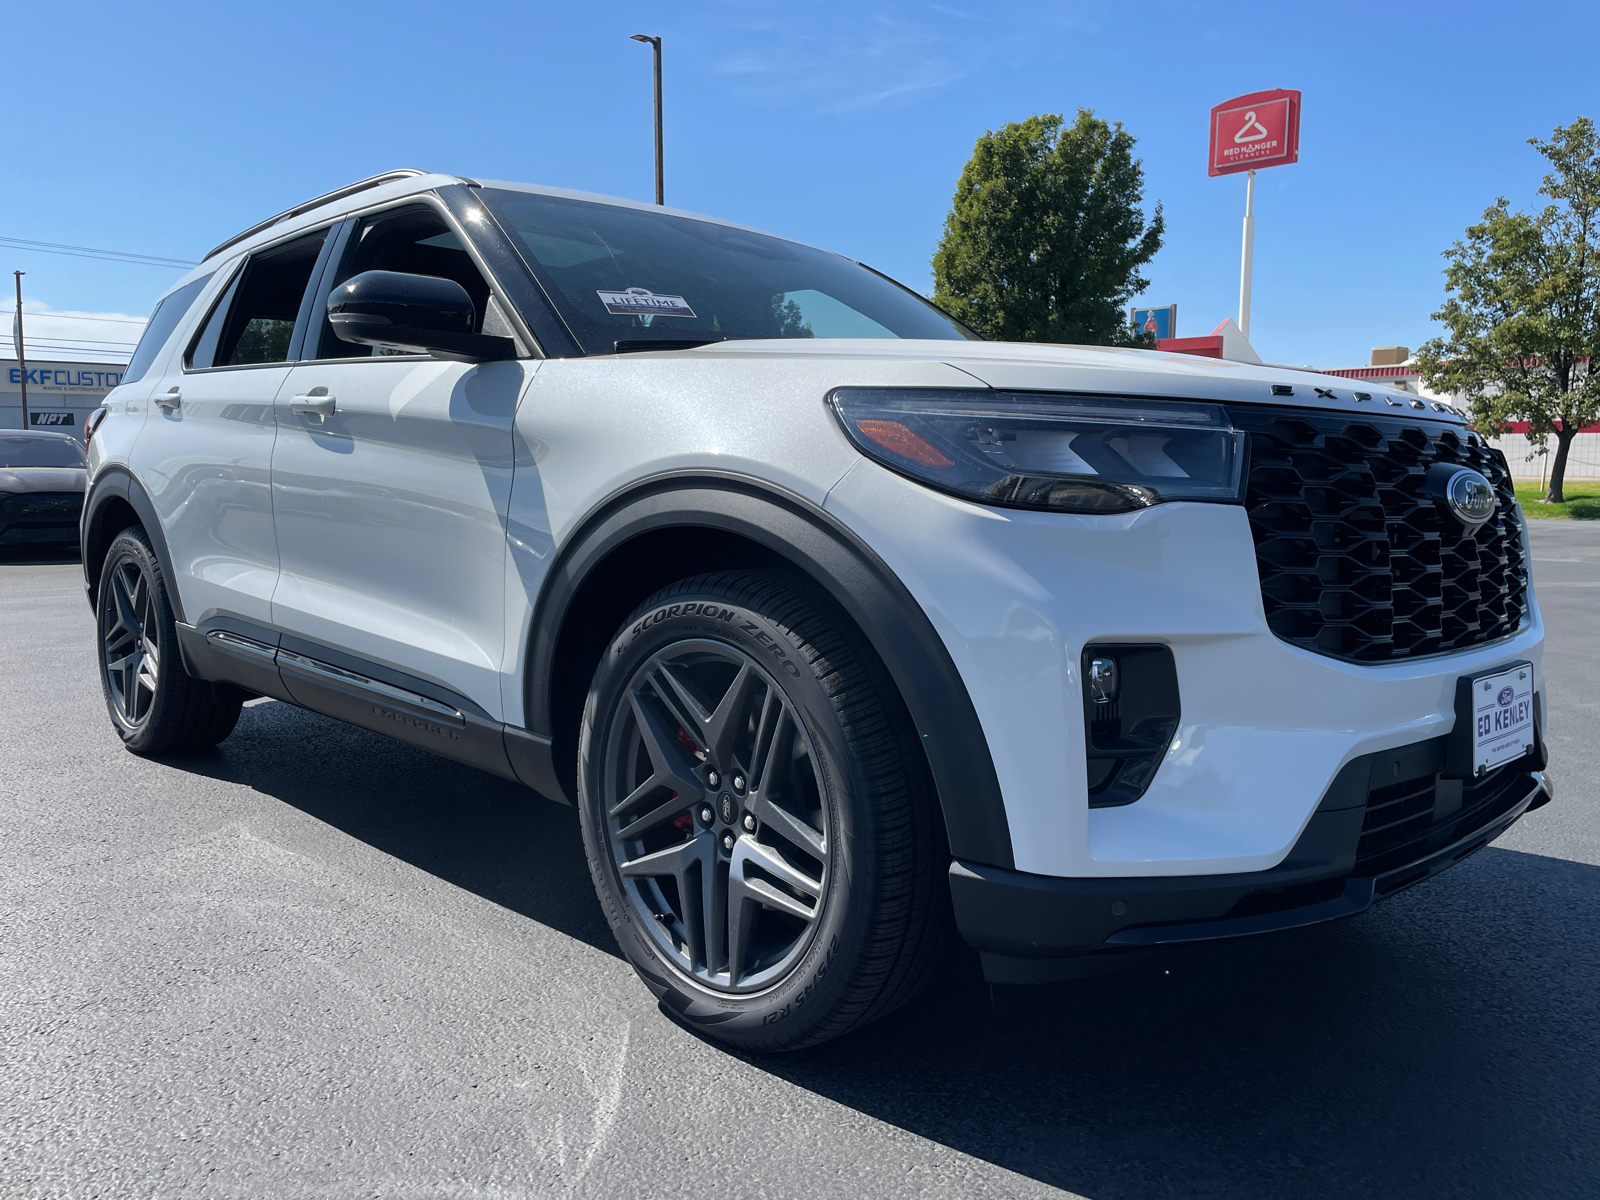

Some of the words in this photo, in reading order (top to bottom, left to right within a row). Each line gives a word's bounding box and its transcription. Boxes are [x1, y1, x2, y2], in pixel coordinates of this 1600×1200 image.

[1223, 147, 1240, 157] RED
[1230, 149, 1270, 161] CLEANERS
[611, 297, 680, 308] LIFETIME
[36, 413, 67, 425] NPT
[632, 603, 735, 641] SCORPION
[739, 620, 801, 680] ZERO
[372, 706, 461, 740] EXPLORER
[1477, 714, 1491, 738] ED
[1494, 700, 1530, 732] KENLEY
[795, 933, 840, 1008] 275/45
[762, 1003, 792, 1028] R21
